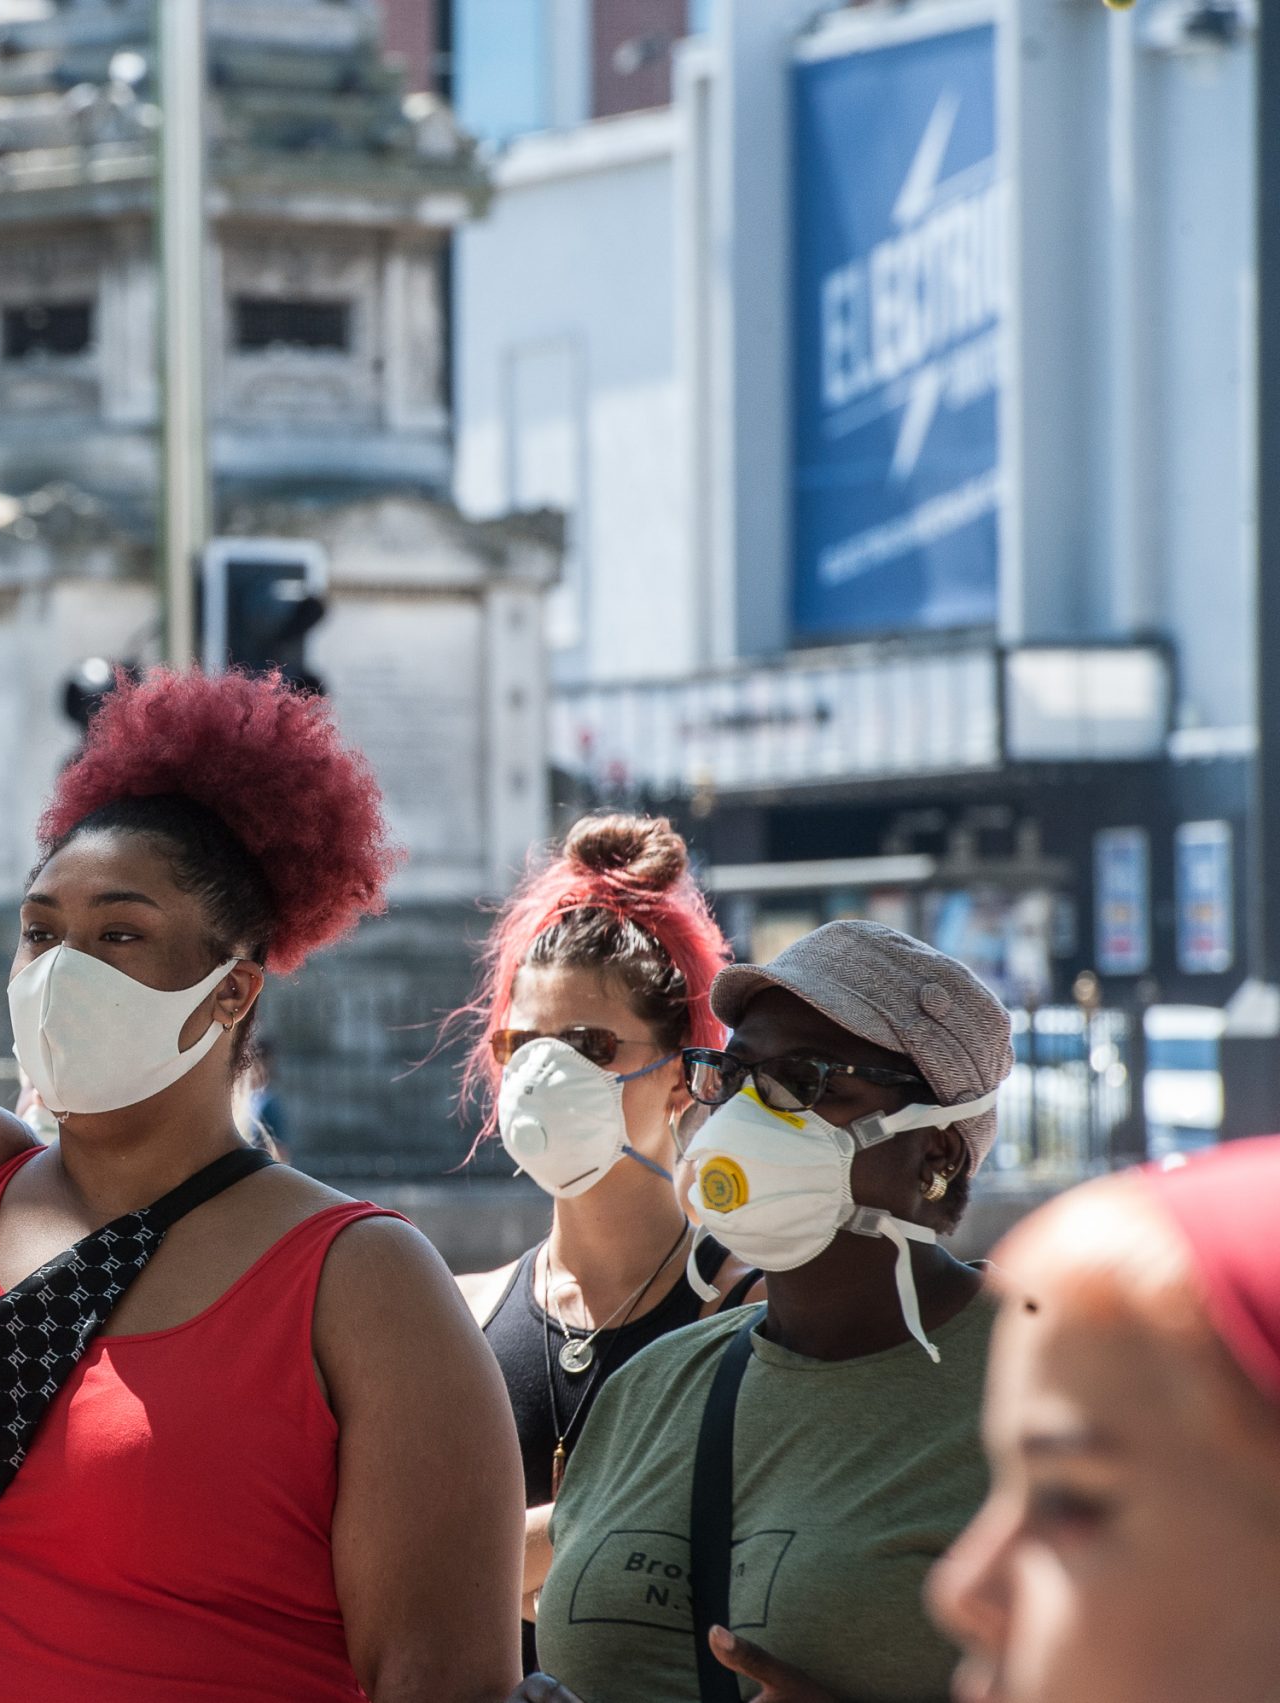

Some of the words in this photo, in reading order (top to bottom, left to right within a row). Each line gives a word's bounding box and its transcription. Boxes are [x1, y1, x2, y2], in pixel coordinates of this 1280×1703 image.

[98, 1230, 120, 1247] PLT
[133, 1227, 154, 1245] PLT
[68, 1256, 88, 1276] PLT
[101, 1256, 121, 1275] PLT
[36, 1285, 56, 1305] PLT
[69, 1286, 90, 1305] PLT
[103, 1283, 121, 1301] PLT
[6, 1315, 26, 1336] PLT
[38, 1316, 58, 1336] PLT
[8, 1347, 28, 1368] PLT
[39, 1348, 60, 1369] PLT
[9, 1381, 28, 1401] PLT
[40, 1378, 58, 1399] PLT
[7, 1415, 28, 1436] PLT
[9, 1447, 27, 1468] PLT
